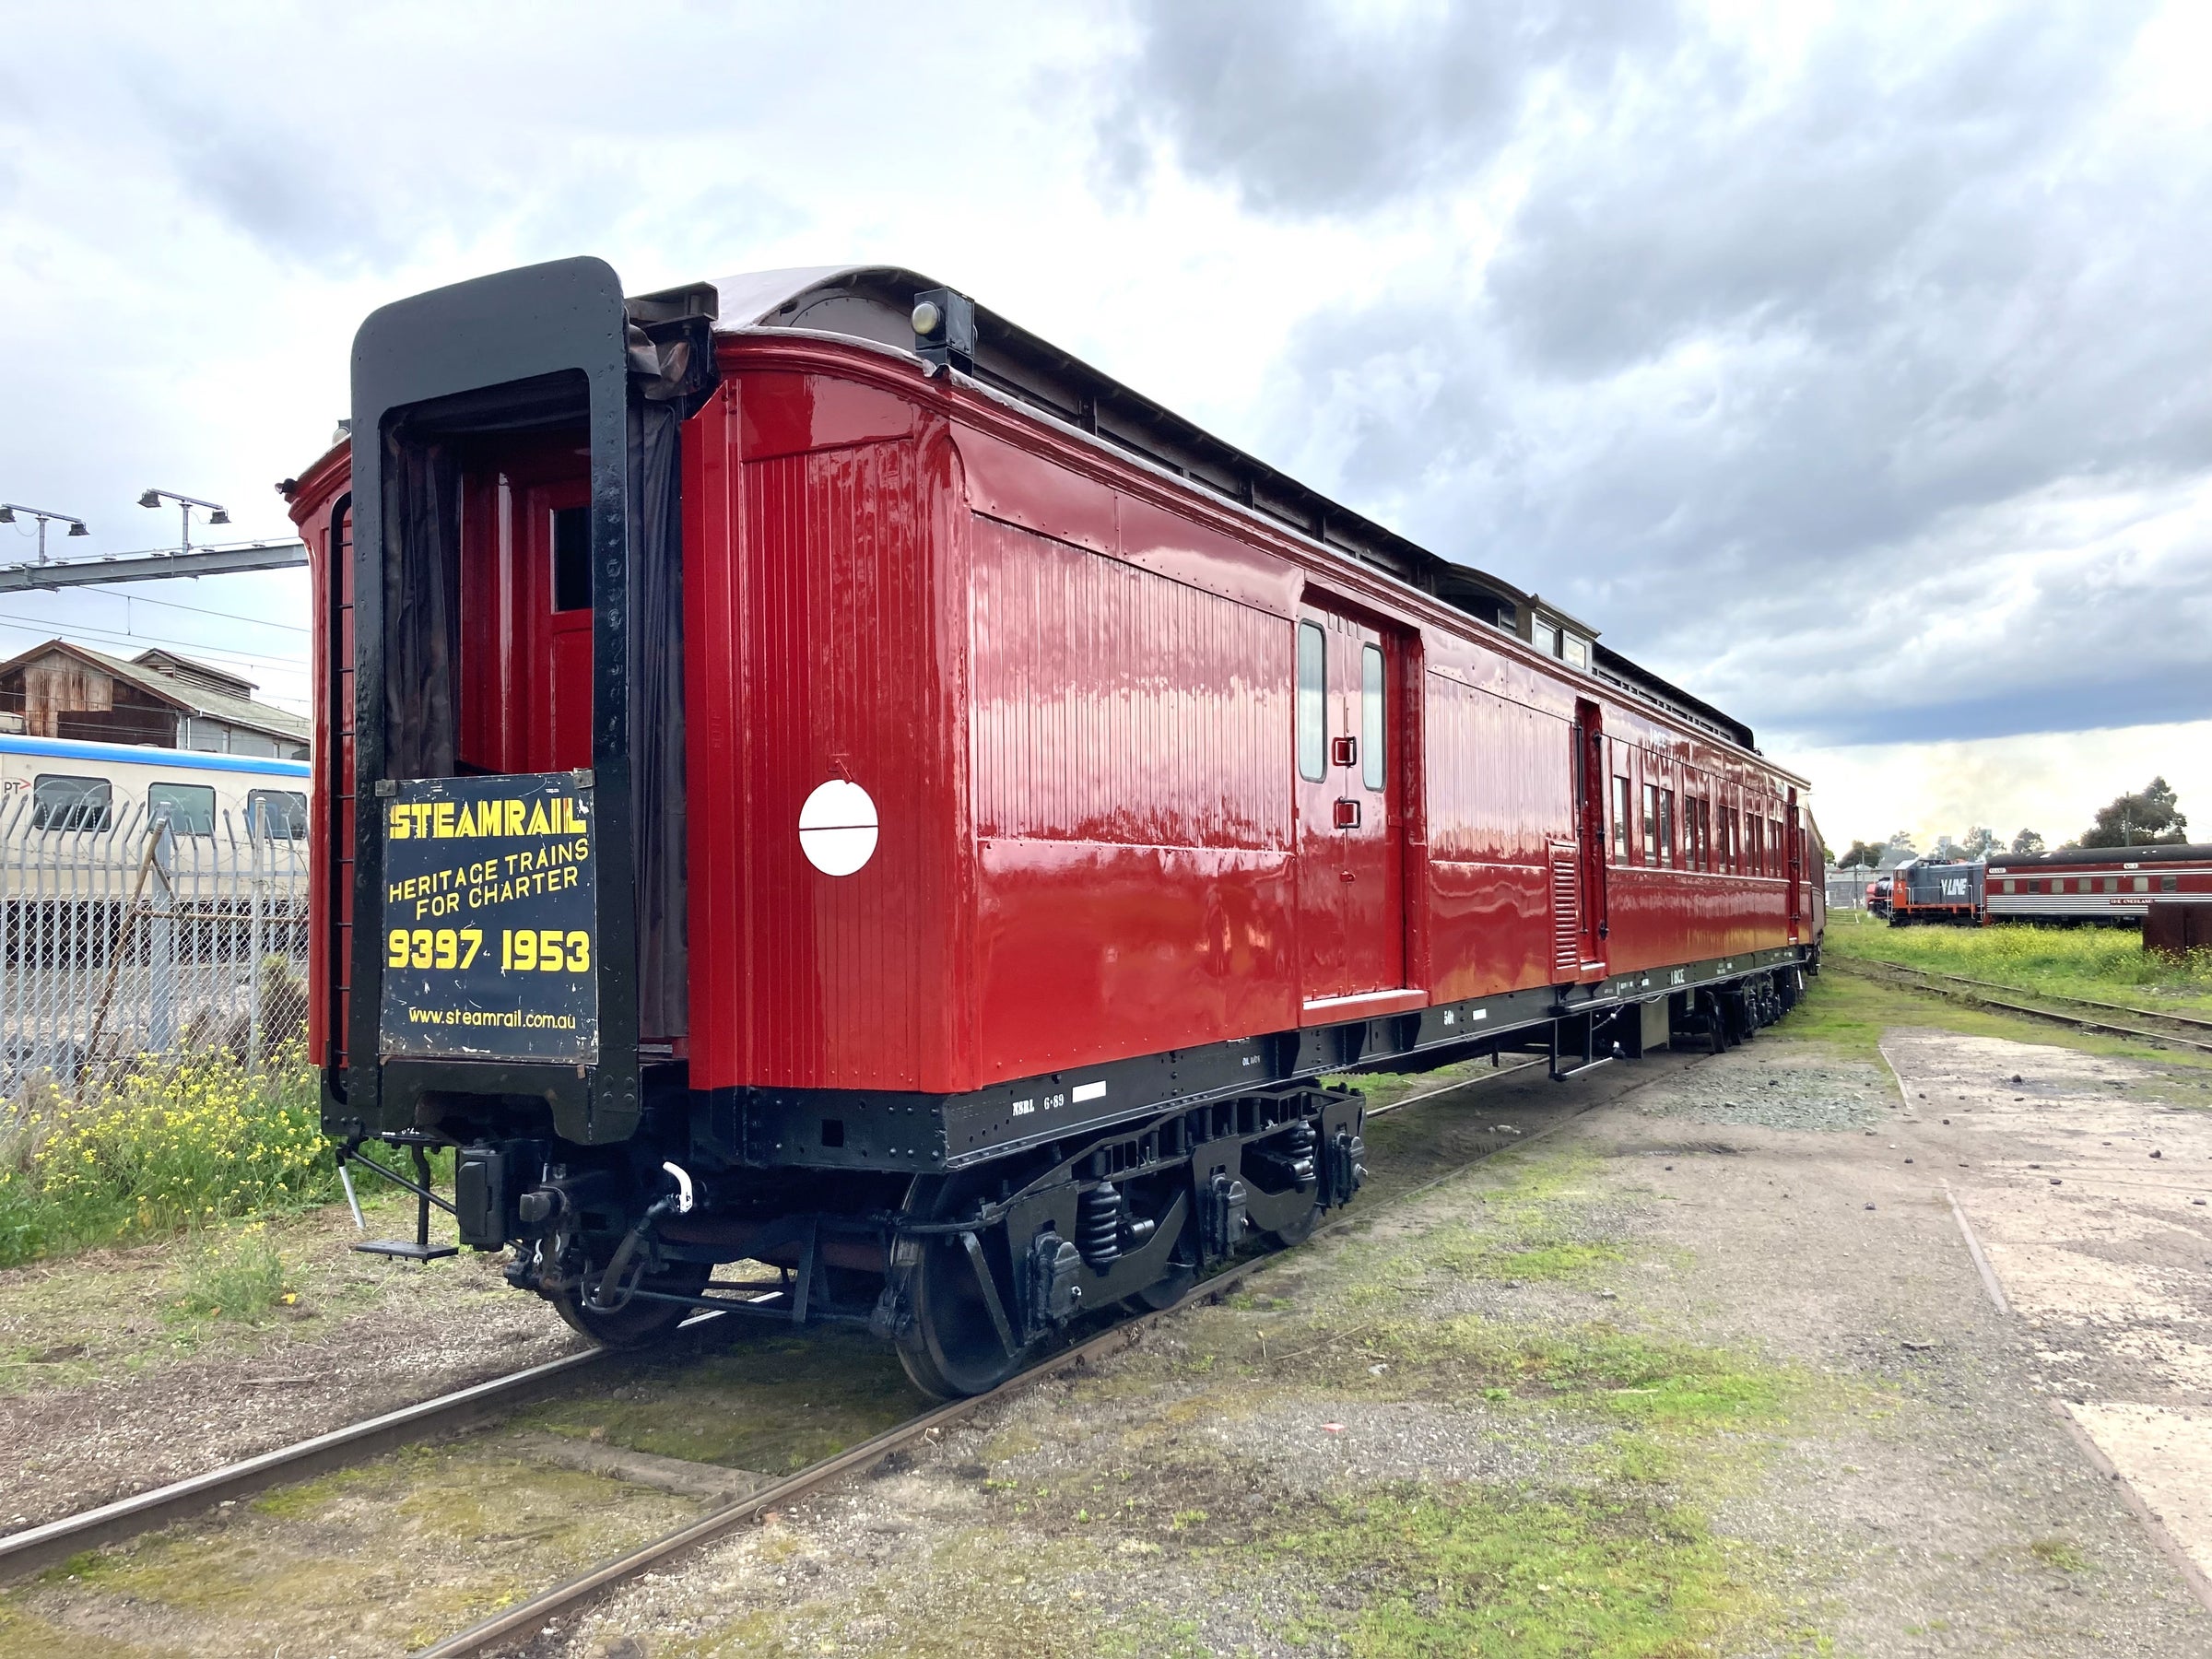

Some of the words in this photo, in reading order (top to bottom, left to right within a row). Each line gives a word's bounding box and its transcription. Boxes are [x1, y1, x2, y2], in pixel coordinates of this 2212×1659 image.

[389, 797, 587, 840] STEAMRAIL
[389, 859, 499, 903] HERITAGE
[505, 838, 589, 876] TRAINS
[416, 891, 460, 921] FOR
[468, 865, 579, 909] CHARTER
[388, 928, 483, 970] 9397
[502, 929, 590, 973] 1953
[408, 1008, 576, 1030] www.steamrail.com.au
